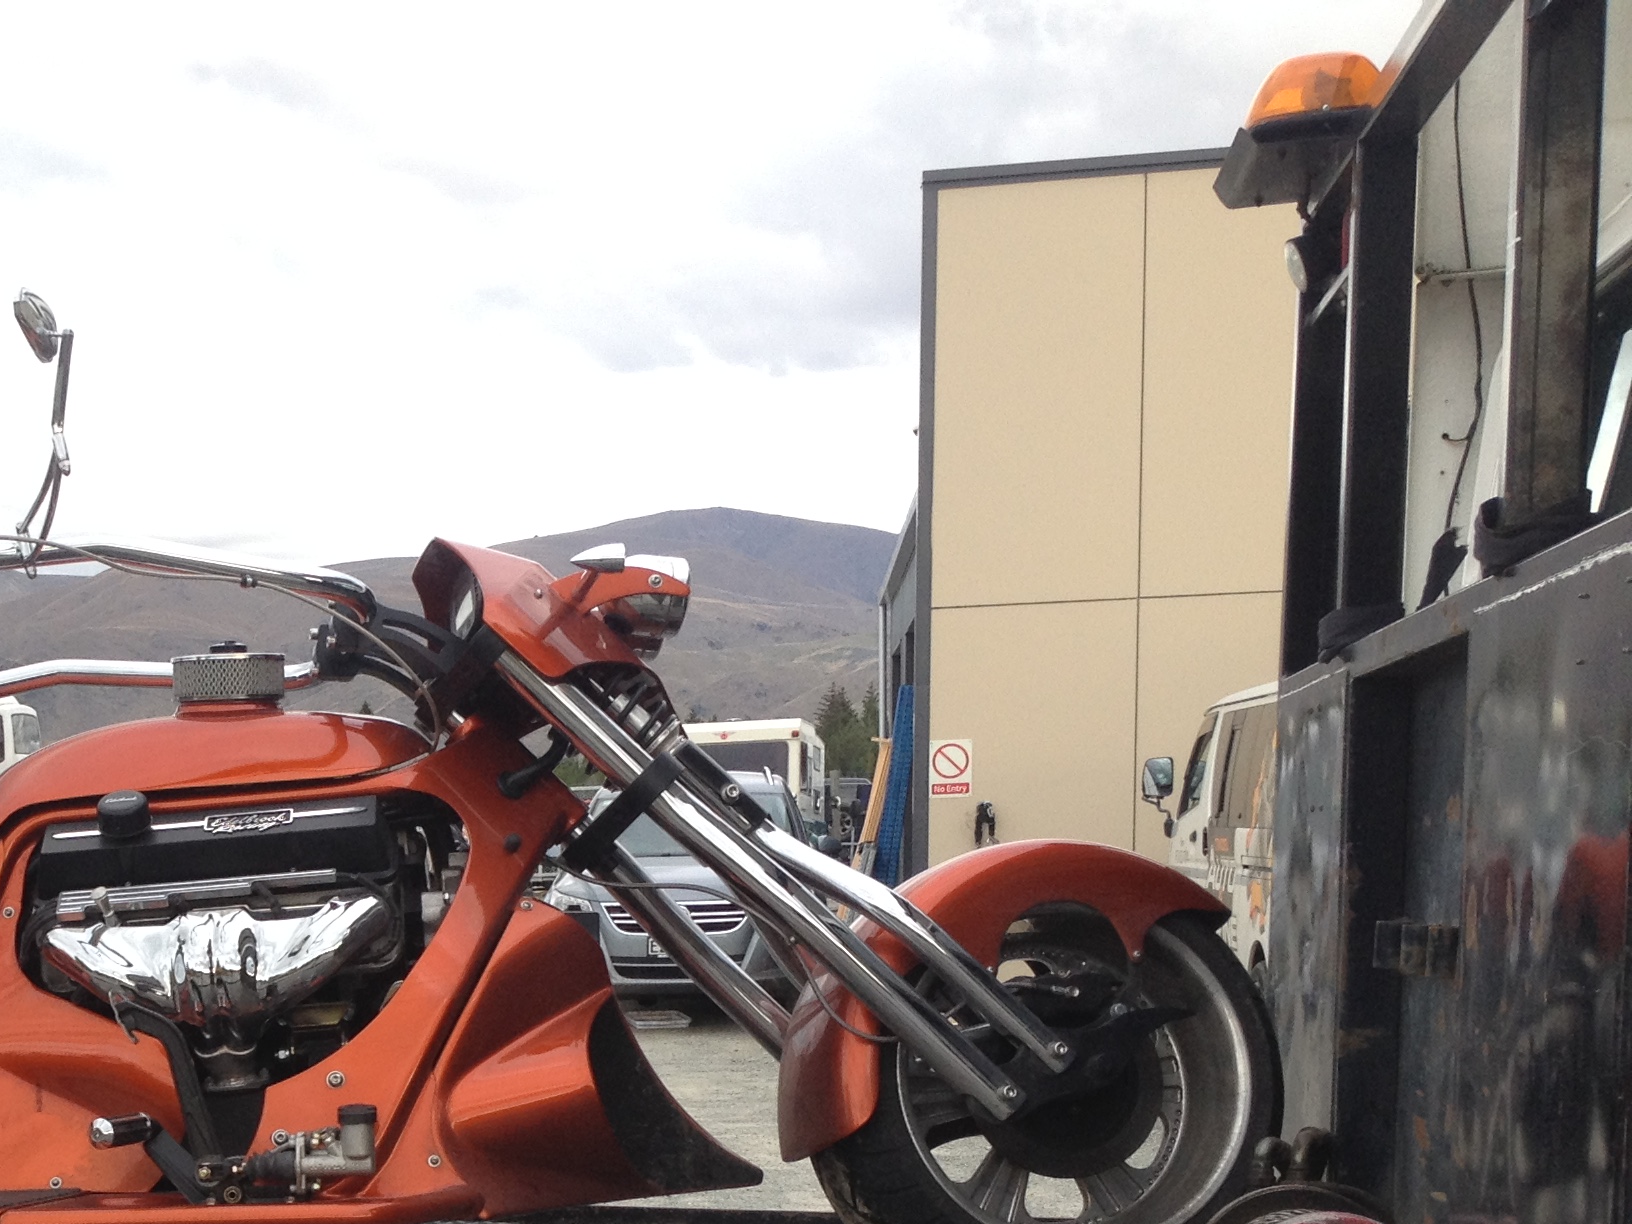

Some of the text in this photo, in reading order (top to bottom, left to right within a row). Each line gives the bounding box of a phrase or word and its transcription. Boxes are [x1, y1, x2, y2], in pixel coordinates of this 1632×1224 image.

[934, 784, 968, 794] No Entry
[210, 812, 286, 827] Edelbrock
